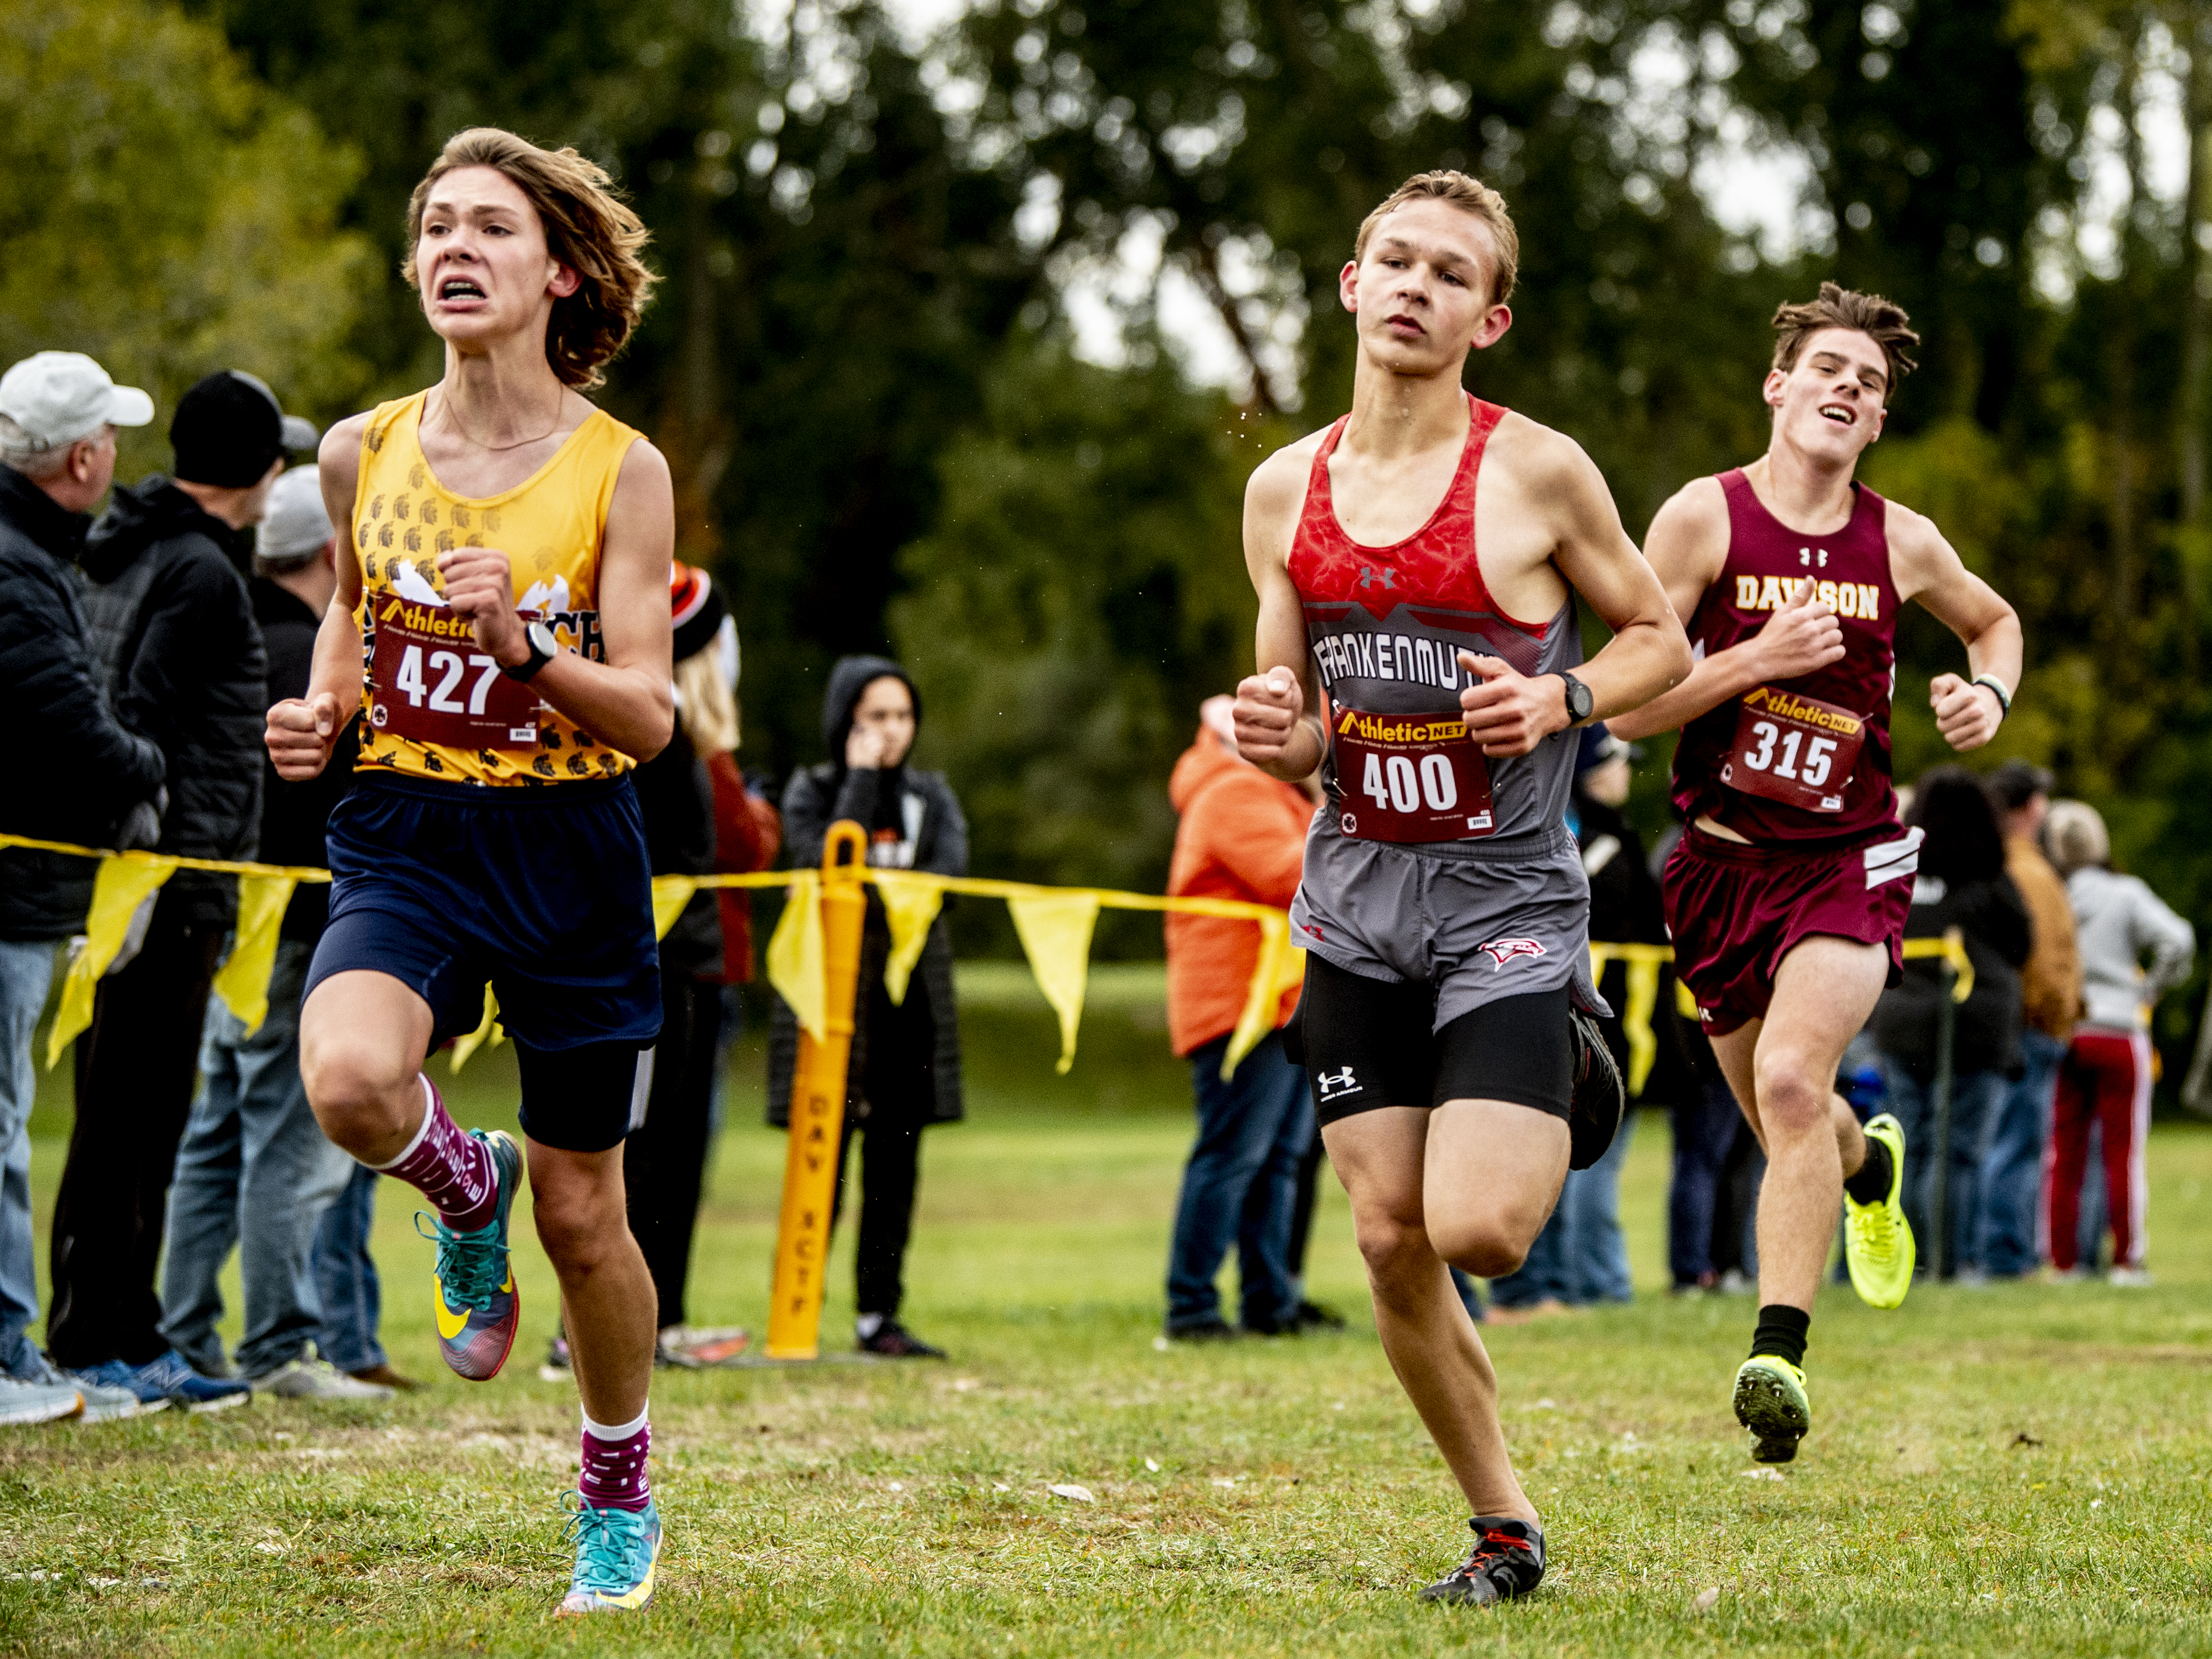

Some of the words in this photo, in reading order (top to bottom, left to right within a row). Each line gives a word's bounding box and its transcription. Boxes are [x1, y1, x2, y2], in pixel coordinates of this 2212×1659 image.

[396, 645, 501, 715] 427
[1313, 633, 1494, 690] FRANKENMUT
[1363, 752, 1457, 813] 400
[1745, 721, 1837, 786] 315
